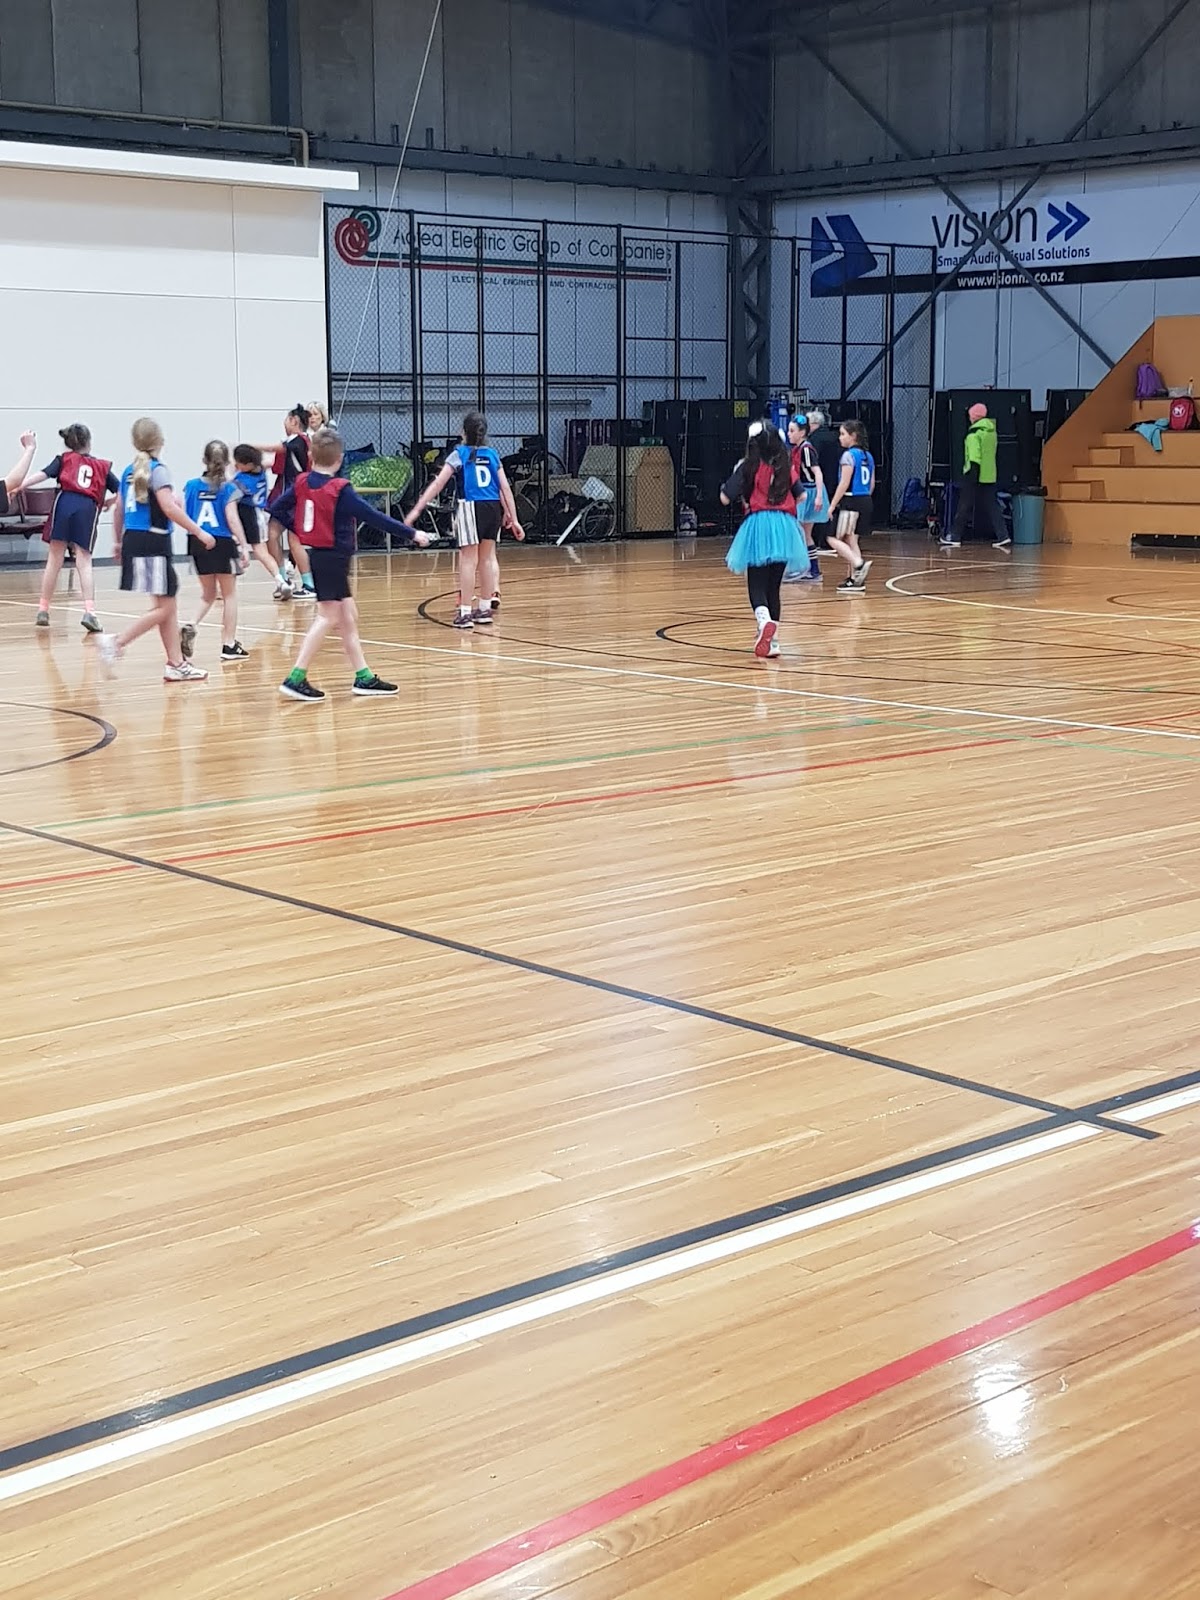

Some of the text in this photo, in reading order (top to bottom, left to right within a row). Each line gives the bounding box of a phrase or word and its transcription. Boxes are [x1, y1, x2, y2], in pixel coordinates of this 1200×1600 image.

[393, 228, 443, 247] Aoea
[452, 230, 506, 251] Electric
[513, 234, 560, 258] Grop
[567, 239, 582, 256] of
[937, 245, 1091, 267] Smar Audio isual Solutions
[452, 275, 499, 285] ELECTCAL
[549, 280, 565, 288] AND
[77, 464, 94, 489] C
[475, 464, 492, 488] D
[861, 466, 871, 485] D
[197, 500, 219, 528] A
